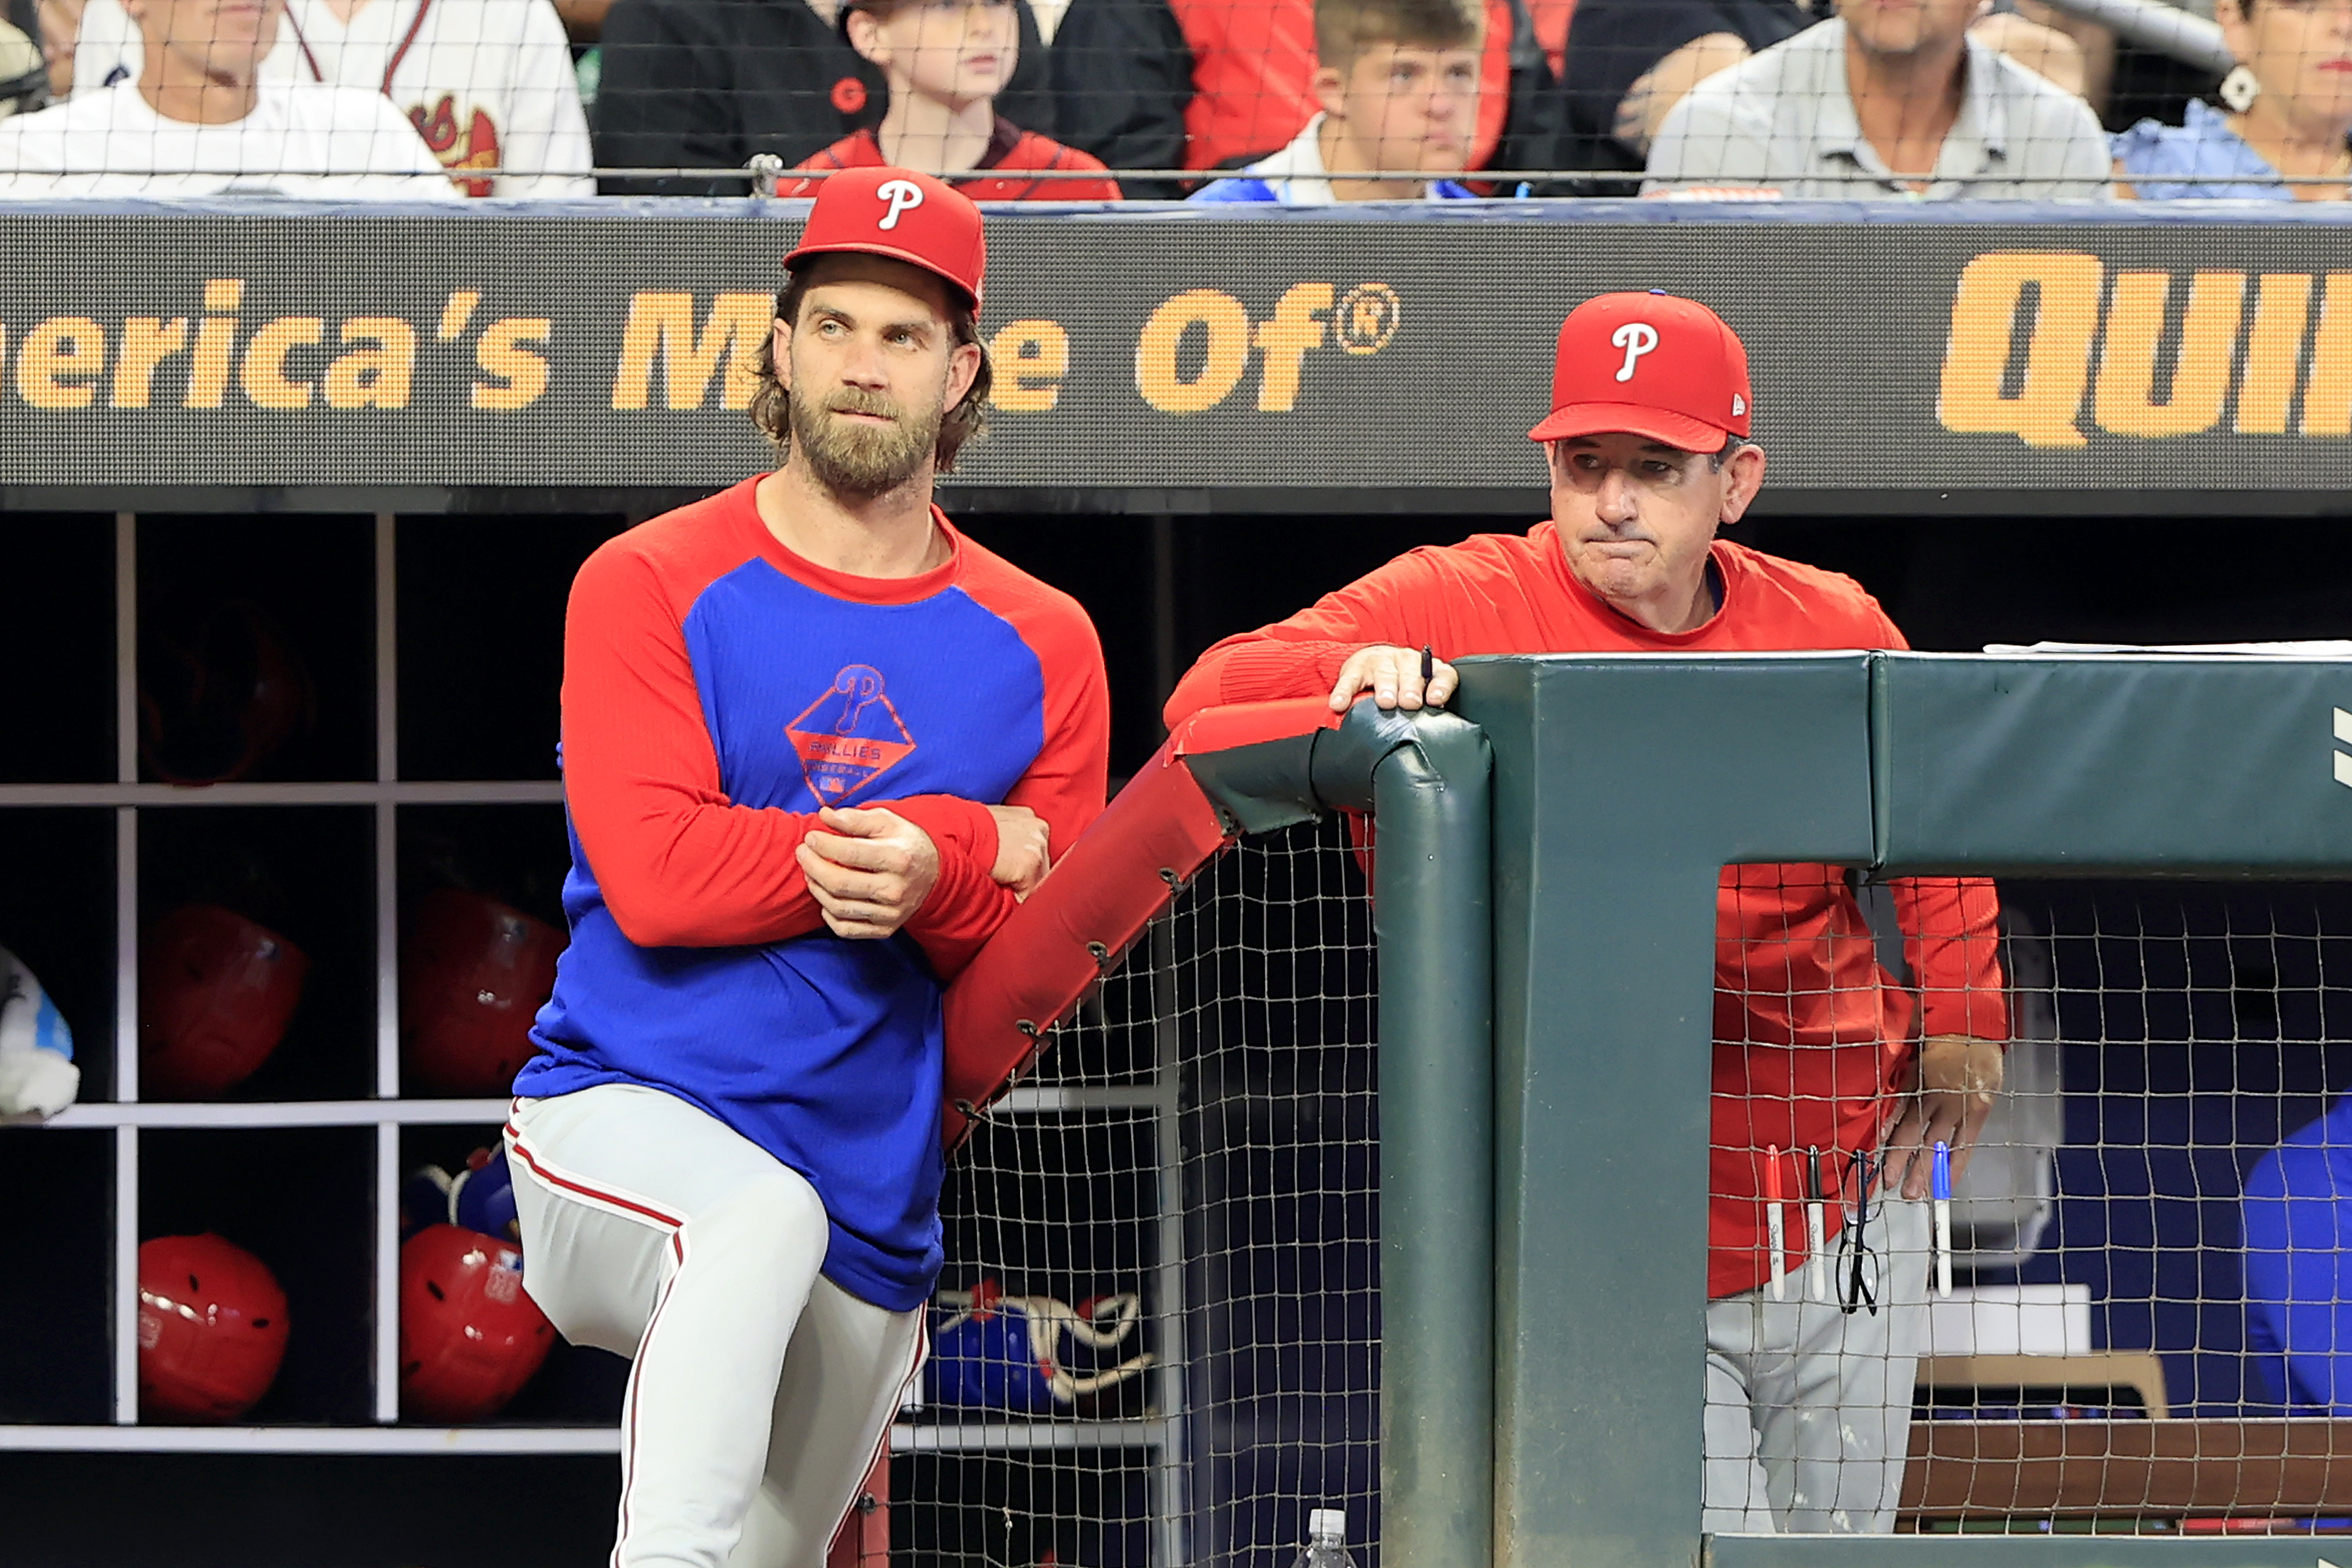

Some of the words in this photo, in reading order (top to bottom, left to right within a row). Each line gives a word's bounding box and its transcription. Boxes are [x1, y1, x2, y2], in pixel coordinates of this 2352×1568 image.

[877, 179, 924, 230] P
[0, 278, 551, 410] erica's
[612, 285, 1069, 412] Me
[1610, 322, 1659, 383] P
